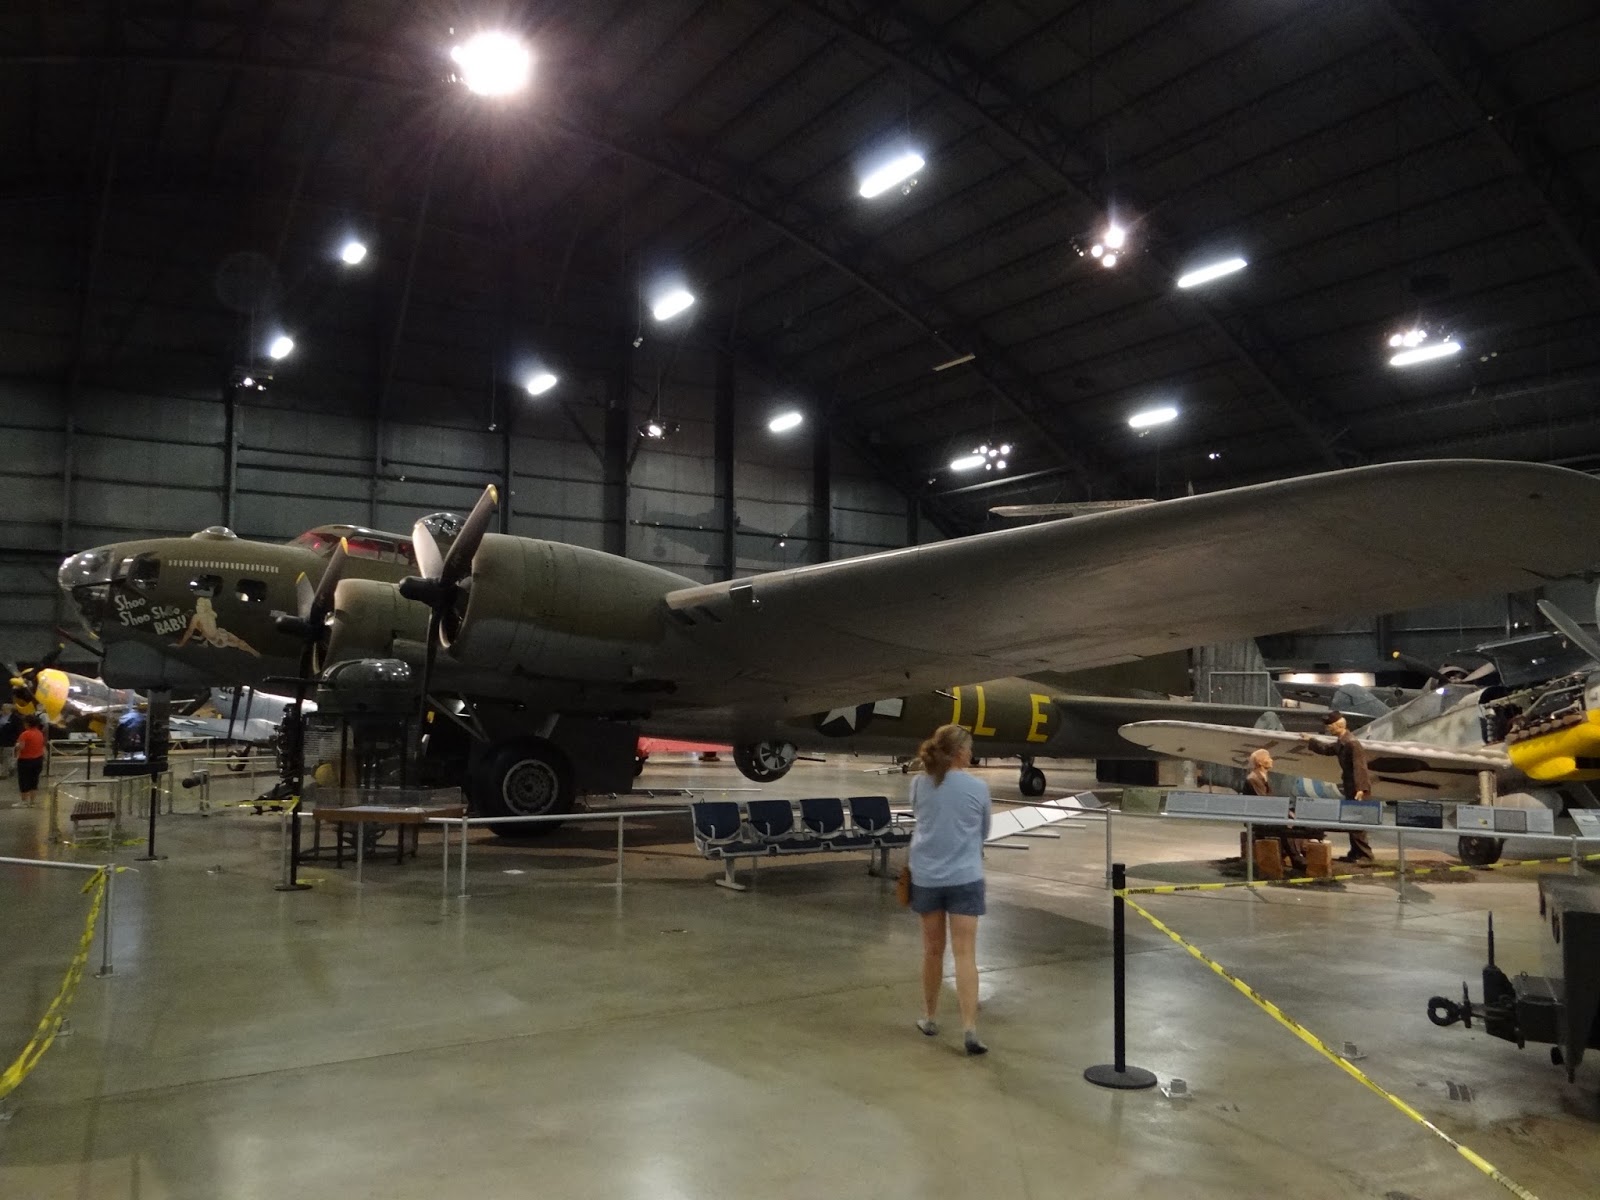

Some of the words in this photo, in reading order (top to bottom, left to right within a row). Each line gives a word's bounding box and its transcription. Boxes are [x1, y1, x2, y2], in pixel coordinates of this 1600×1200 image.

[114, 594, 146, 611] Shoo
[119, 611, 151, 626] Shoo
[153, 614, 187, 635] BABY
[1026, 693, 1051, 743] E
